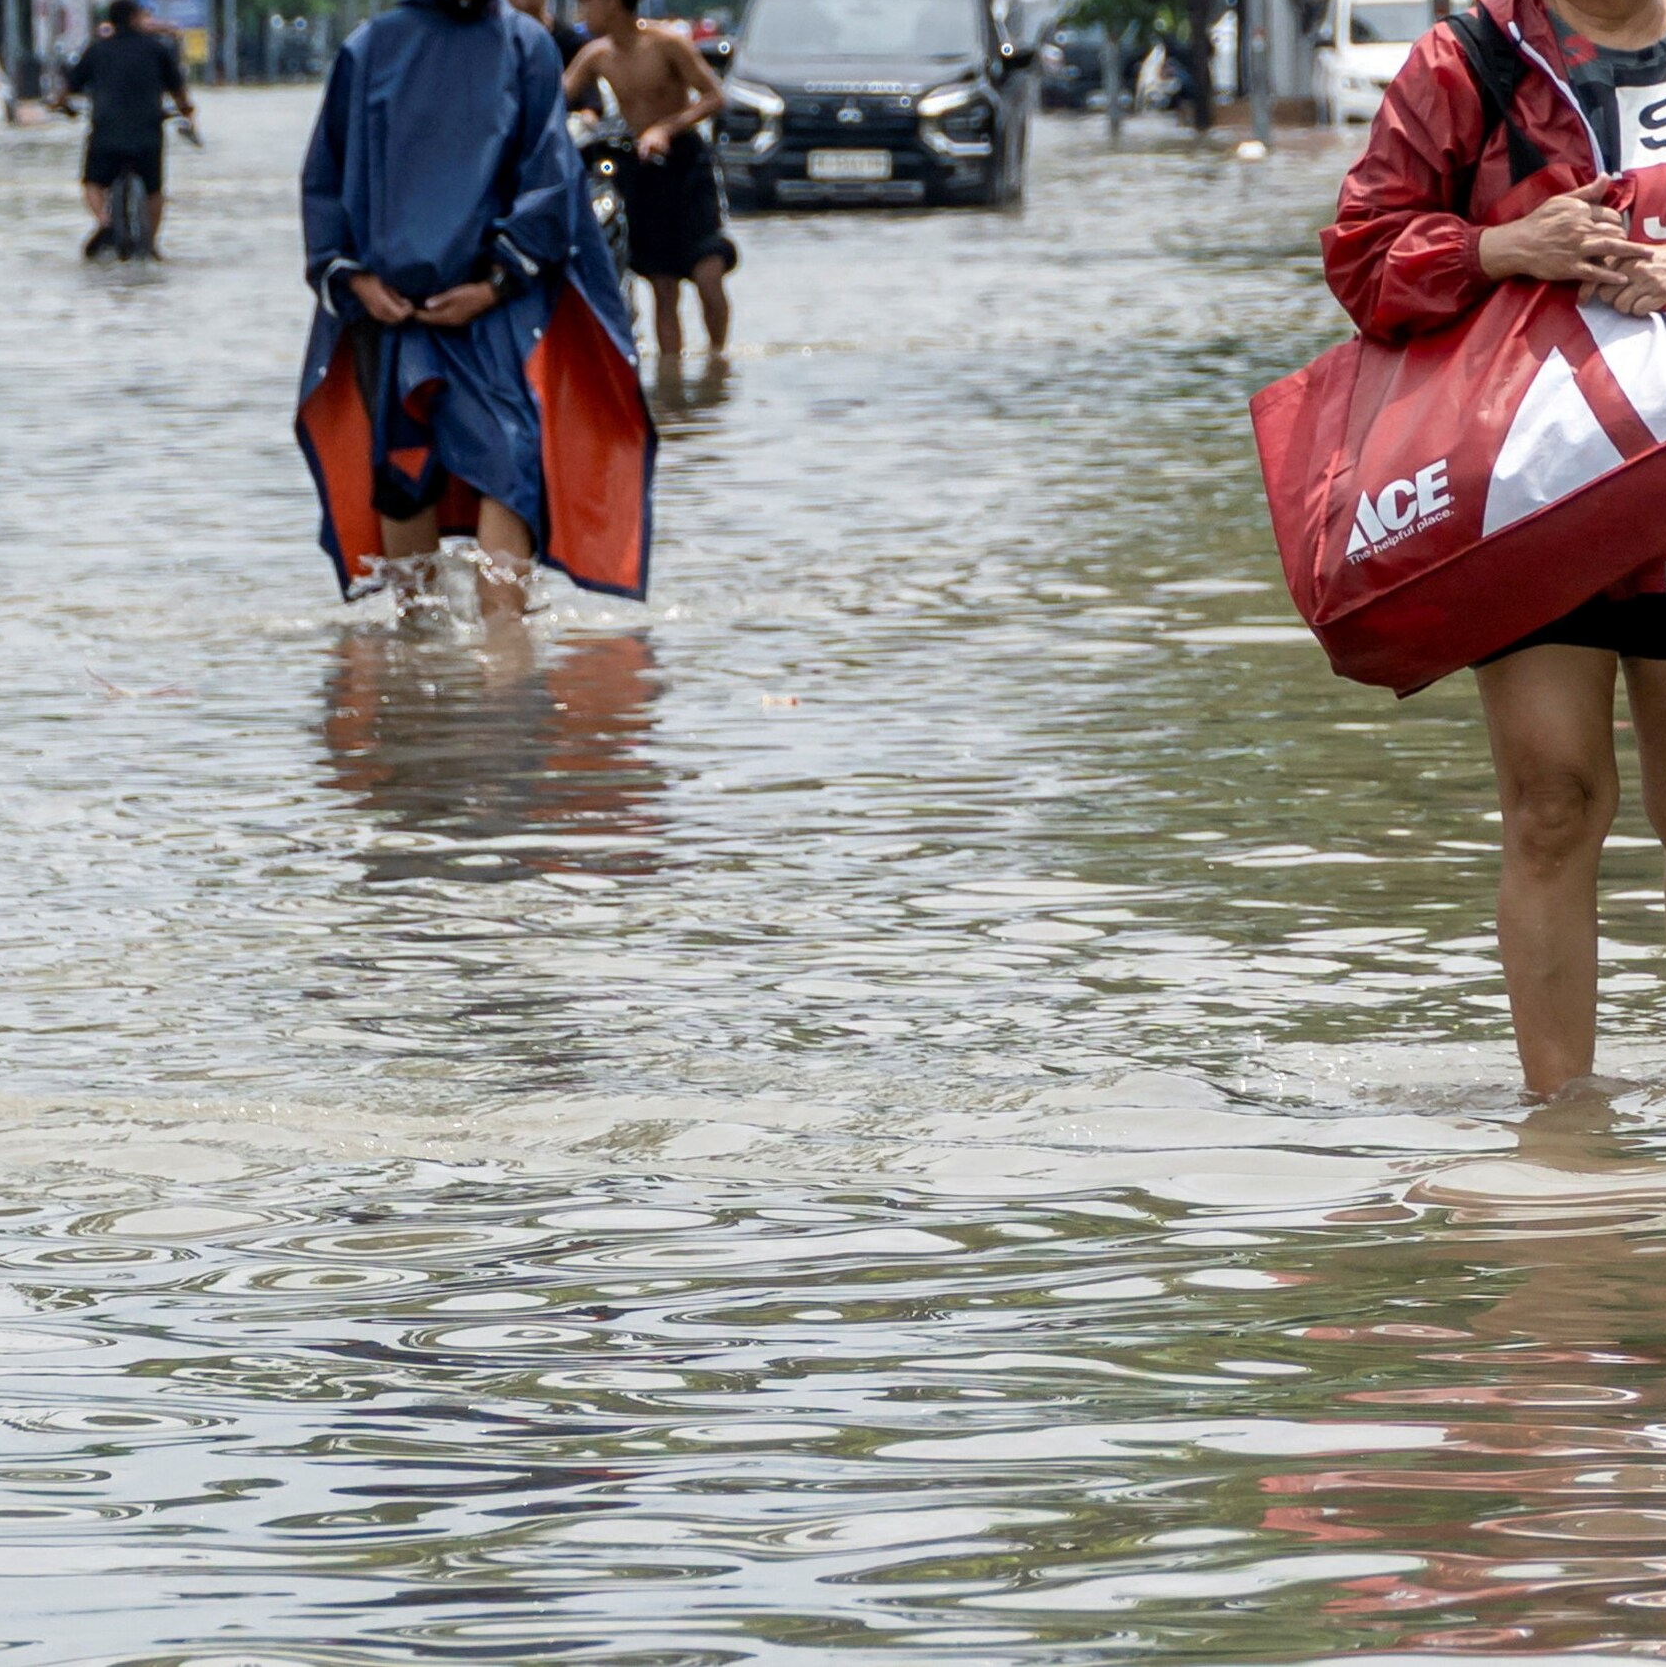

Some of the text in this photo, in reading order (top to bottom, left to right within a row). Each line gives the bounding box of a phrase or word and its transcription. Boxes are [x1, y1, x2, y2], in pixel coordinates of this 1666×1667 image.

[1345, 458, 1450, 556] ACE
[1346, 550, 1371, 565] The
[1373, 525, 1415, 554] helpful
